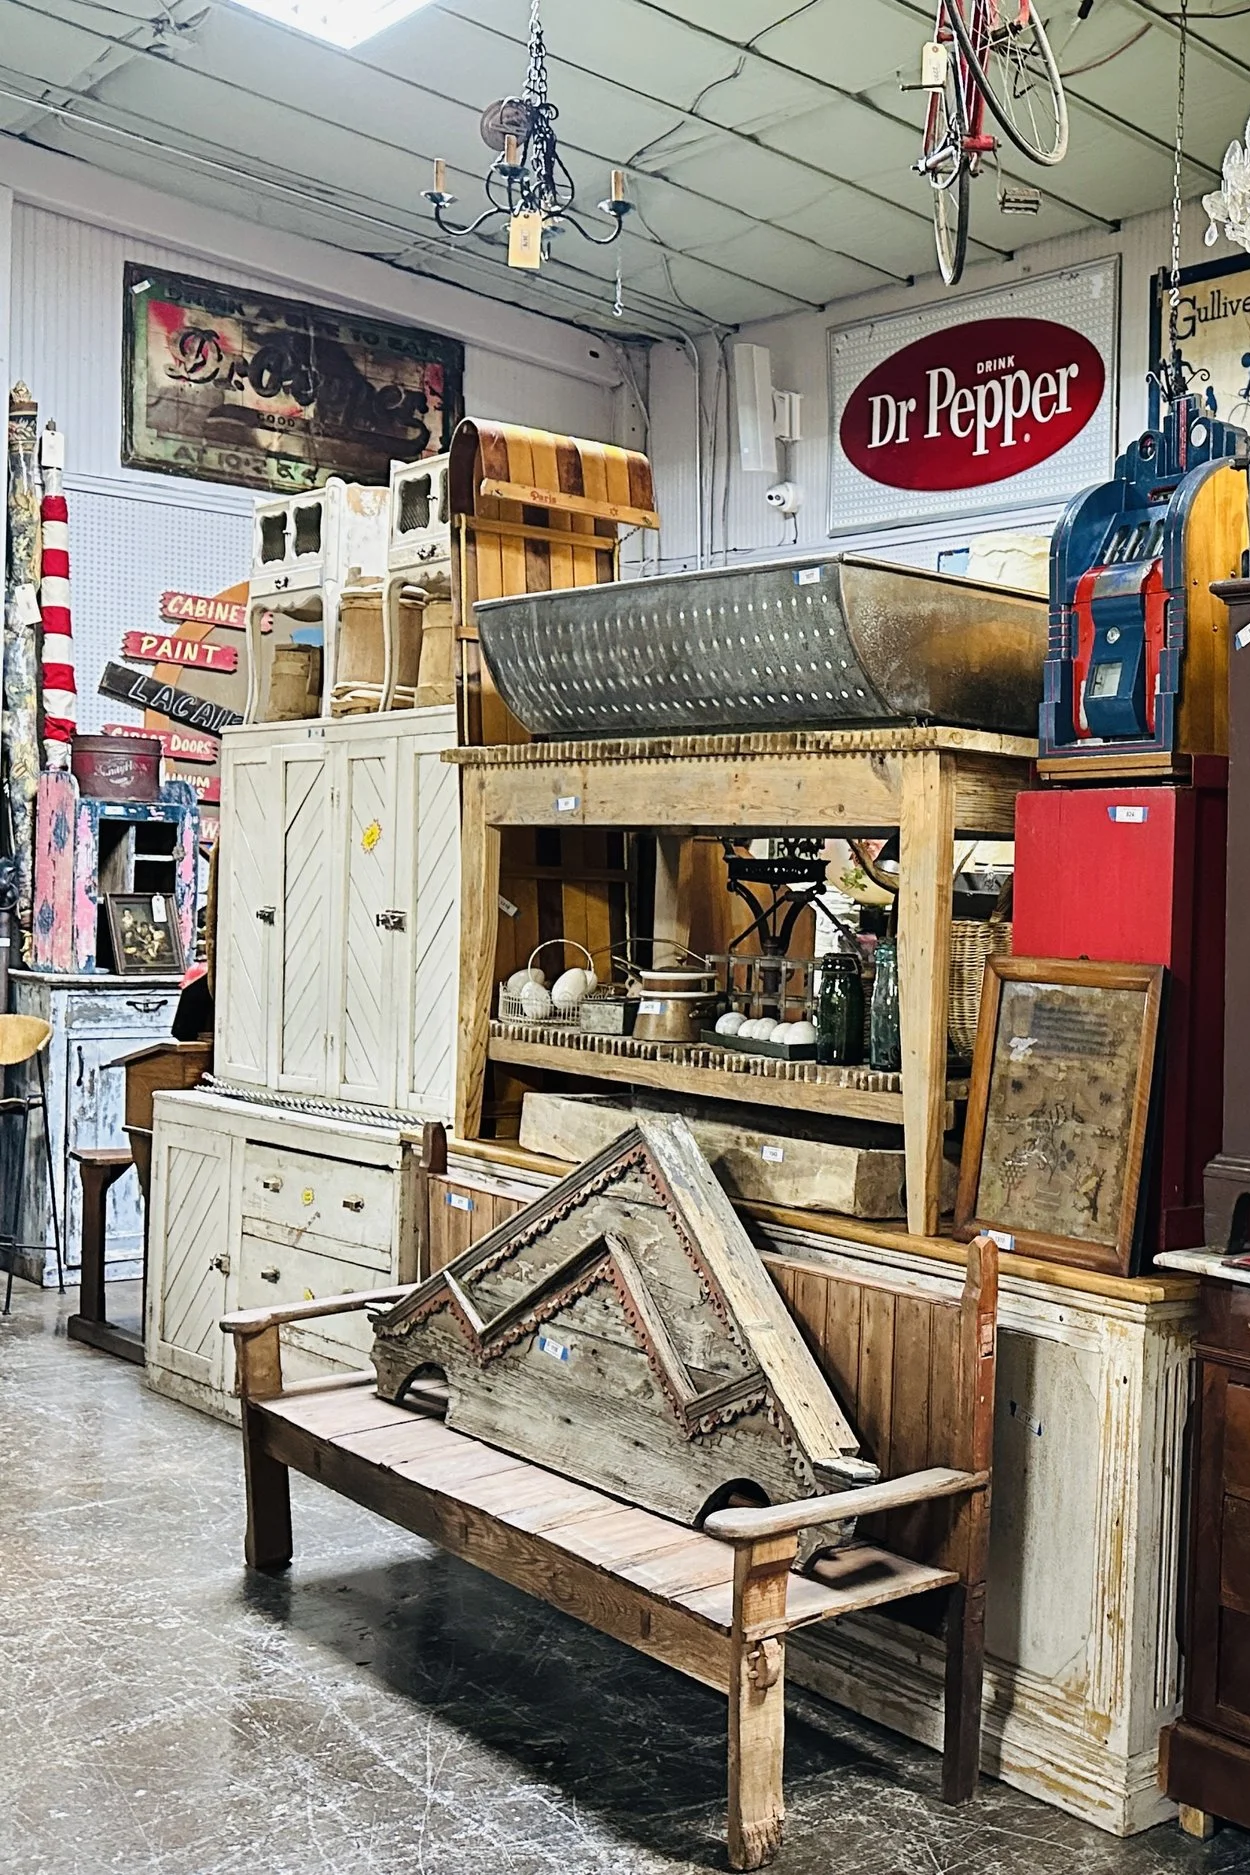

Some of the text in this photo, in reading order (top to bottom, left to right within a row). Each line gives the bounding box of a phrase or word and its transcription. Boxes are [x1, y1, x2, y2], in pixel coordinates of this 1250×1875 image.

[976, 354, 1016, 375] DRINK
[256, 411, 297, 429] GOOD
[867, 362, 1080, 457] Dr Pepper
[140, 636, 222, 665] PAINT
